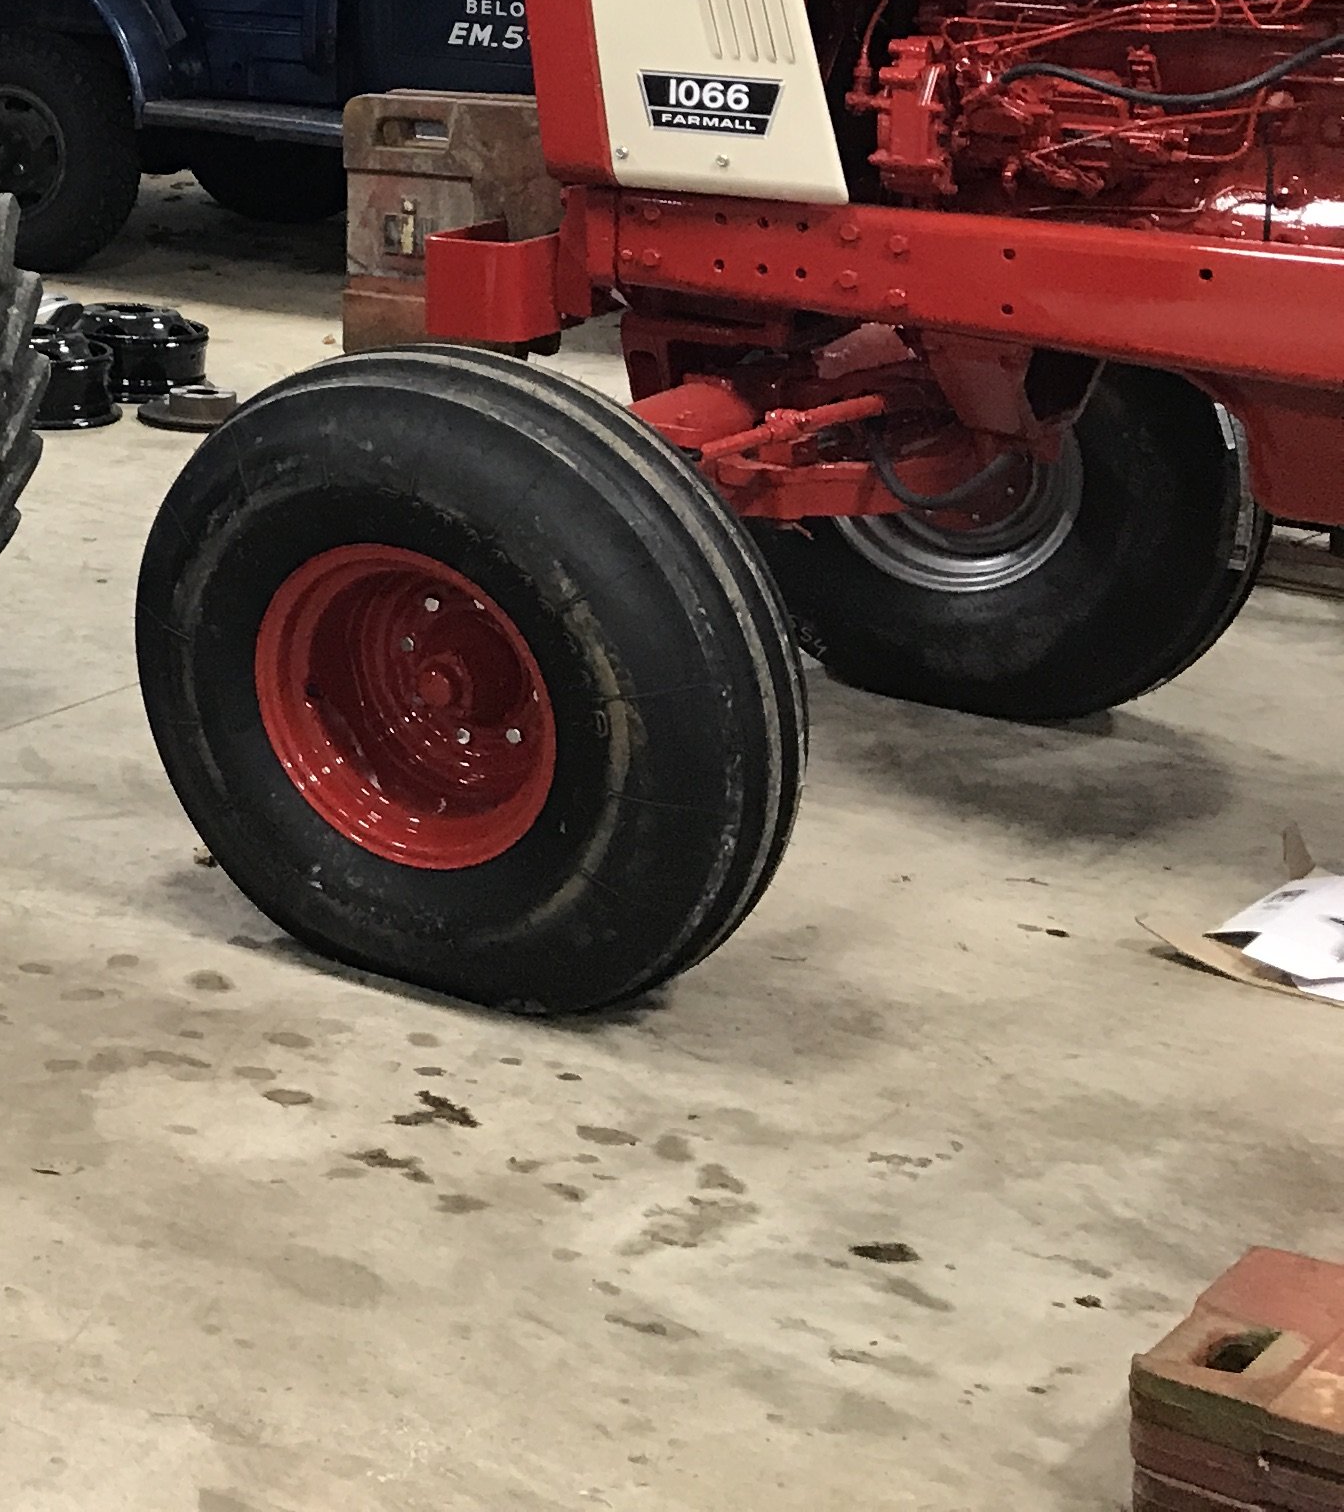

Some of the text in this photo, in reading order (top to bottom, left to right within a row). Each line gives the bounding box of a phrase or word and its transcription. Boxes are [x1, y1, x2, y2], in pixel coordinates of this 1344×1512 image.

[466, 0, 525, 17] BELO
[448, 22, 531, 49] EM.5
[669, 78, 750, 111] 1066
[661, 113, 756, 131] FARMALL
